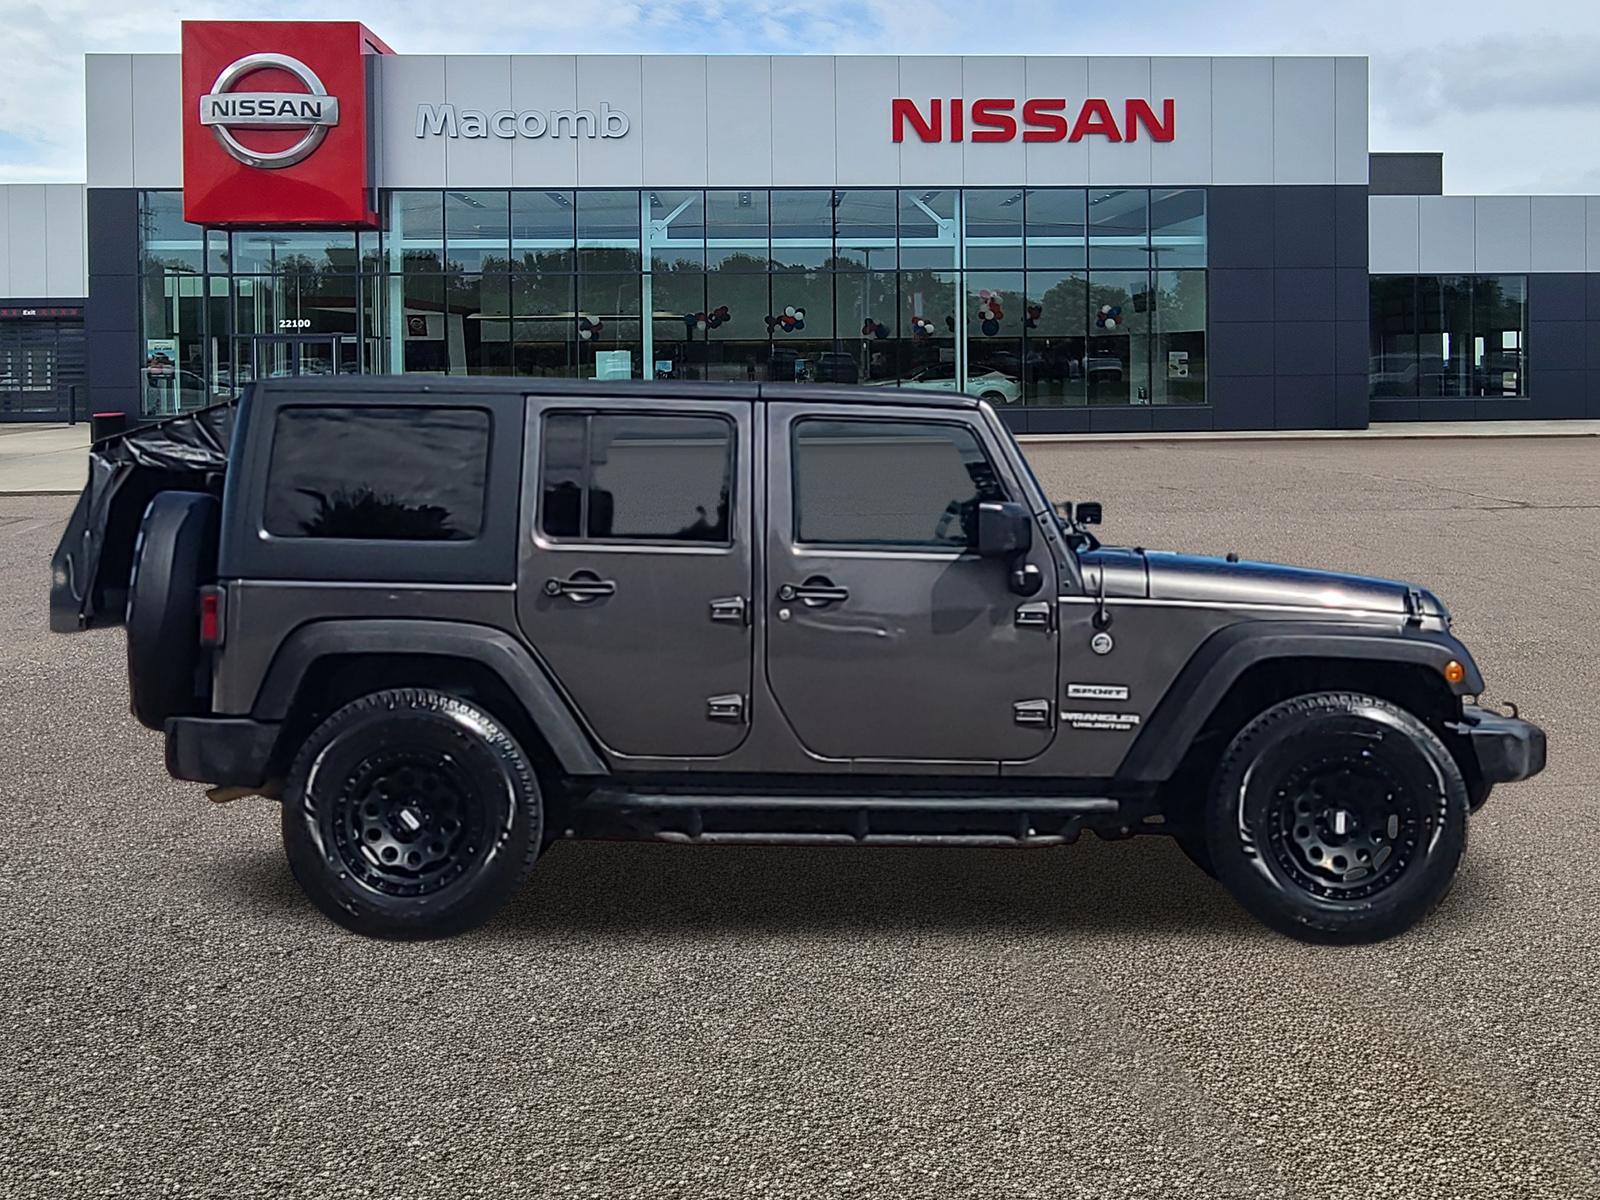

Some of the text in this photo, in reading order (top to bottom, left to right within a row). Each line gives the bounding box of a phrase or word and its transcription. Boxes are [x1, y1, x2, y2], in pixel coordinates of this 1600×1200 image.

[211, 99, 322, 118] NISSAN
[415, 101, 631, 140] Macomb
[891, 98, 1176, 143] NISSAN
[279, 319, 311, 328] 22100
[1071, 687, 1122, 696] SPORT
[1060, 711, 1140, 724] WRANGLER
